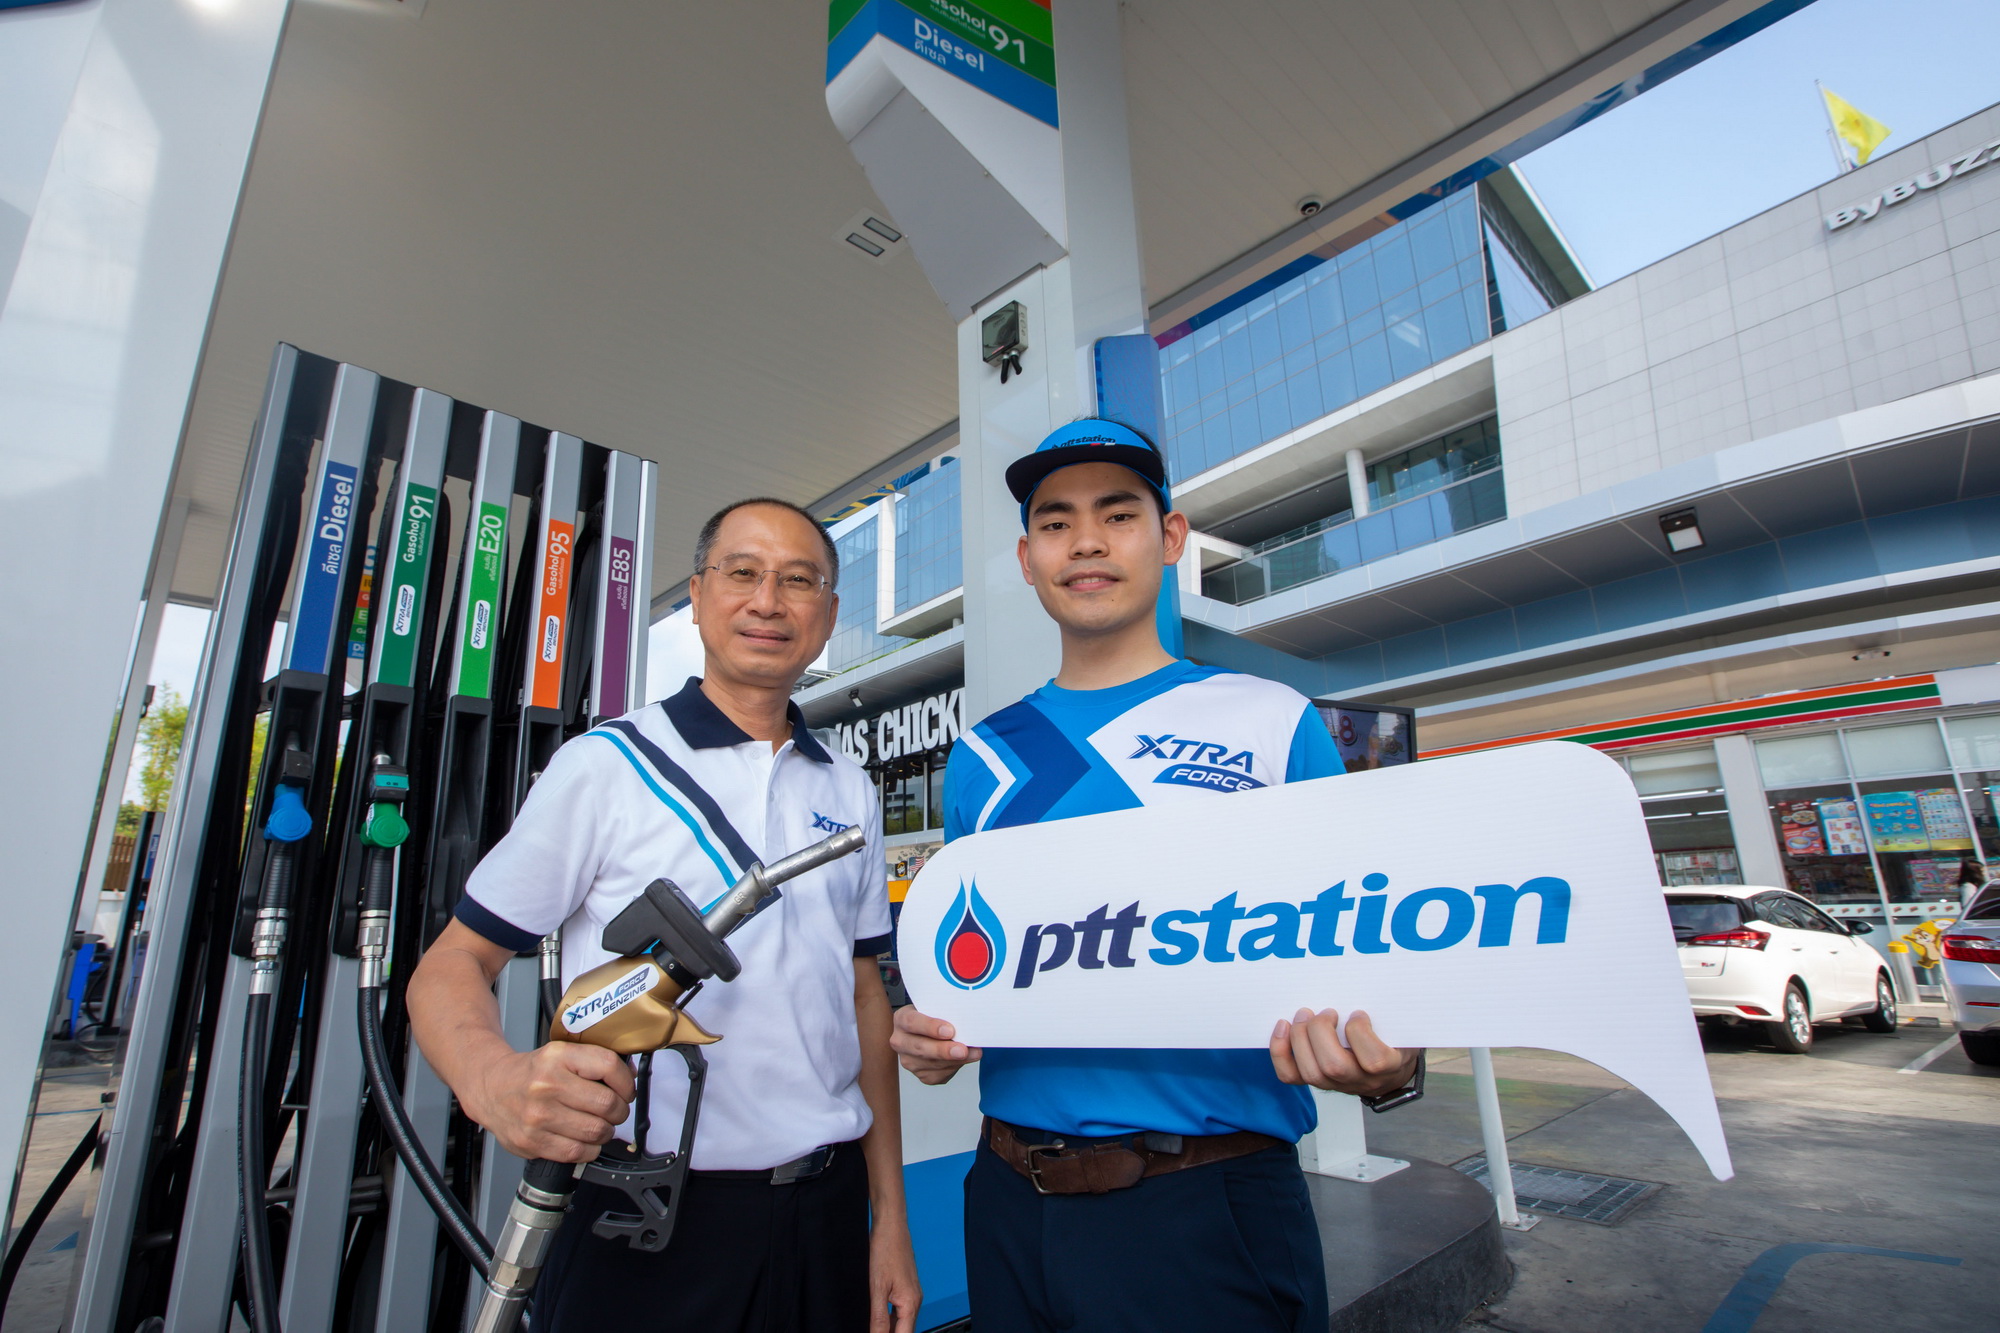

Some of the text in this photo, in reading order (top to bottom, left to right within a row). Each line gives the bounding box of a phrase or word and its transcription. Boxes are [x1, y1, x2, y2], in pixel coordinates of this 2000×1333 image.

[914, 18, 984, 72] Diesel
[914, 38, 946, 66] ดีเซล
[988, 25, 1026, 64] 91
[320, 473, 354, 575] ดีเซล Diesel
[402, 494, 434, 563] Gasohol 91
[478, 514, 502, 554] E20
[546, 531, 570, 596] Gasohol 95
[611, 547, 631, 584] E85
[395, 608, 407, 632] XTRA
[473, 622, 483, 646] XTRA
[544, 637, 553, 660] XTRA
[1127, 734, 1254, 775] XTRA
[1171, 768, 1253, 791] FORCE
[566, 972, 645, 1026] XTRA FORCE
[602, 982, 647, 1016] BENZINE
